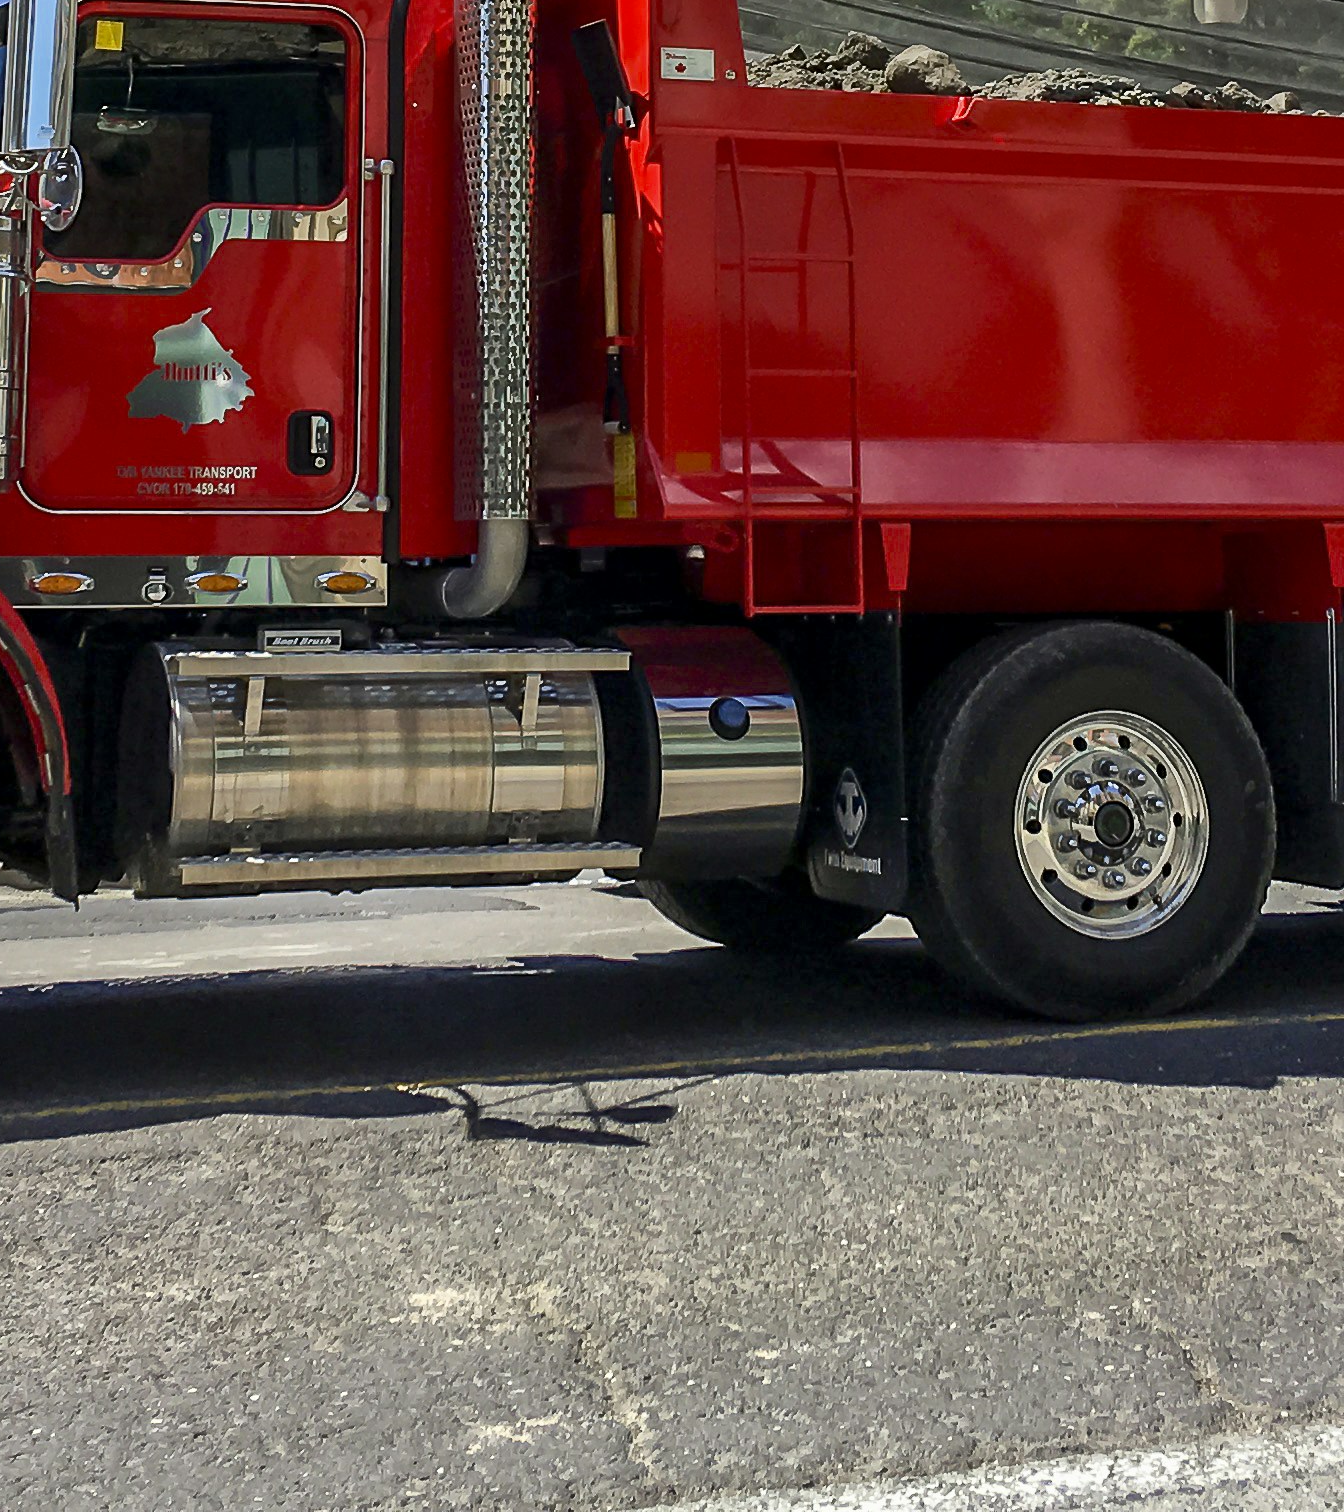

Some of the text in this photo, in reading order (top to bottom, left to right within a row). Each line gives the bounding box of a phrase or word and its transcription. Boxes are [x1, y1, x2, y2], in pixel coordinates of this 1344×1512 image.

[140, 466, 185, 478] YANKEE
[188, 466, 257, 479] TRANSPORT
[136, 482, 169, 495] CVOR
